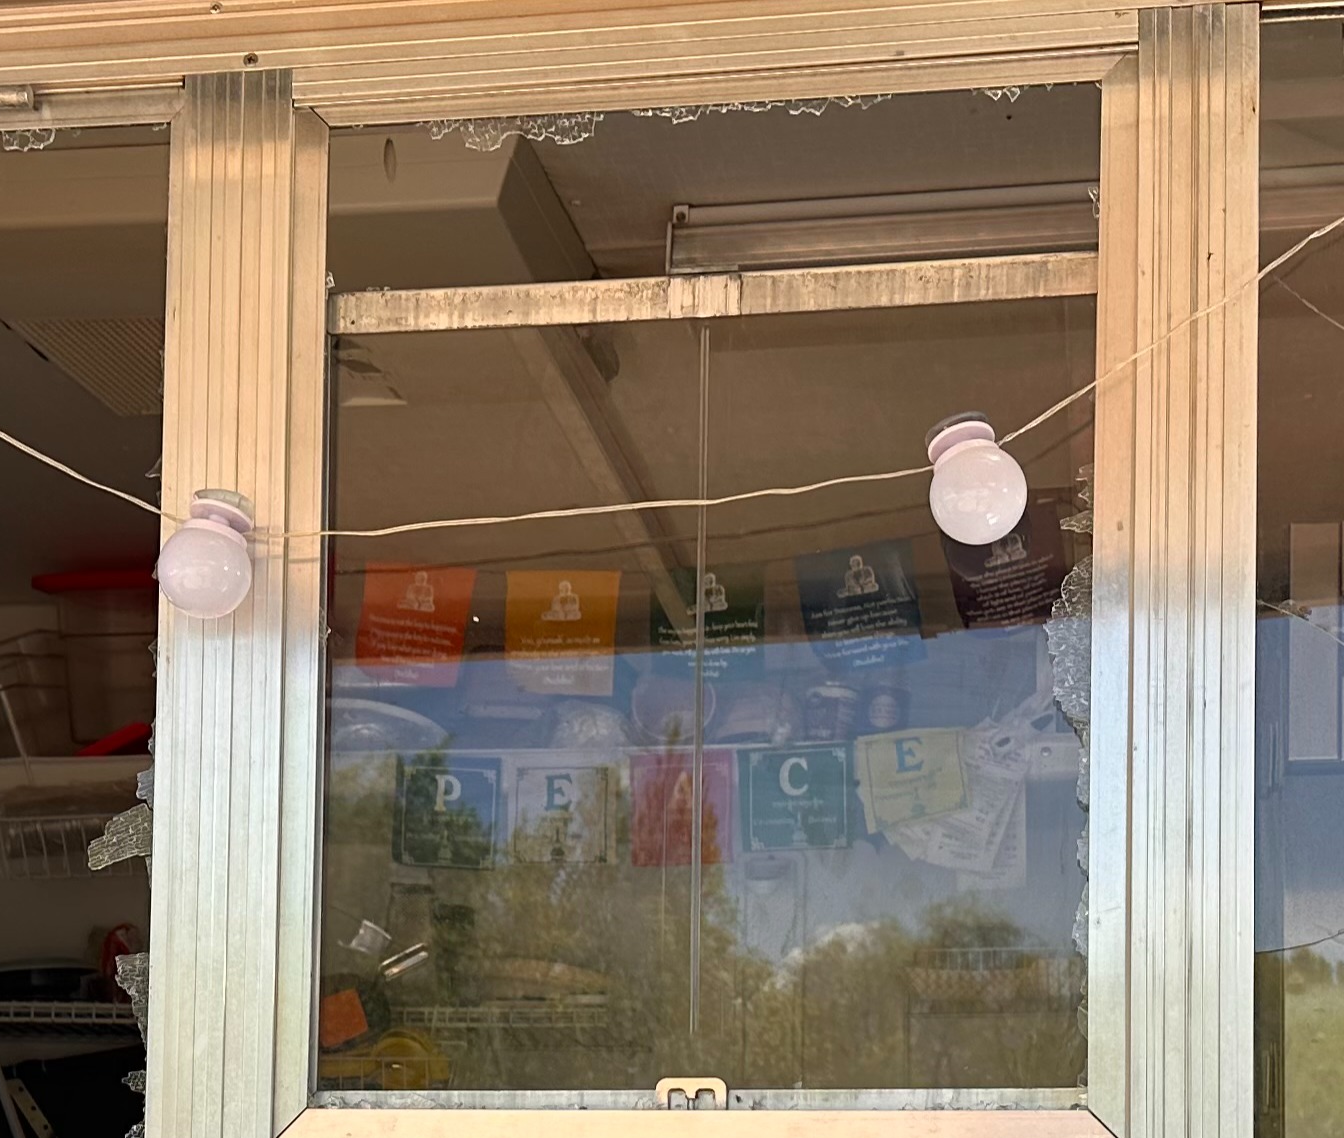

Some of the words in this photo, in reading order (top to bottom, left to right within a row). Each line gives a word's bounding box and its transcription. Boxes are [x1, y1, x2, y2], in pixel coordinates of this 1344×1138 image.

[435, 774, 462, 811] P
[545, 773, 572, 812] E
[779, 757, 808, 797] C
[895, 737, 924, 773] E
